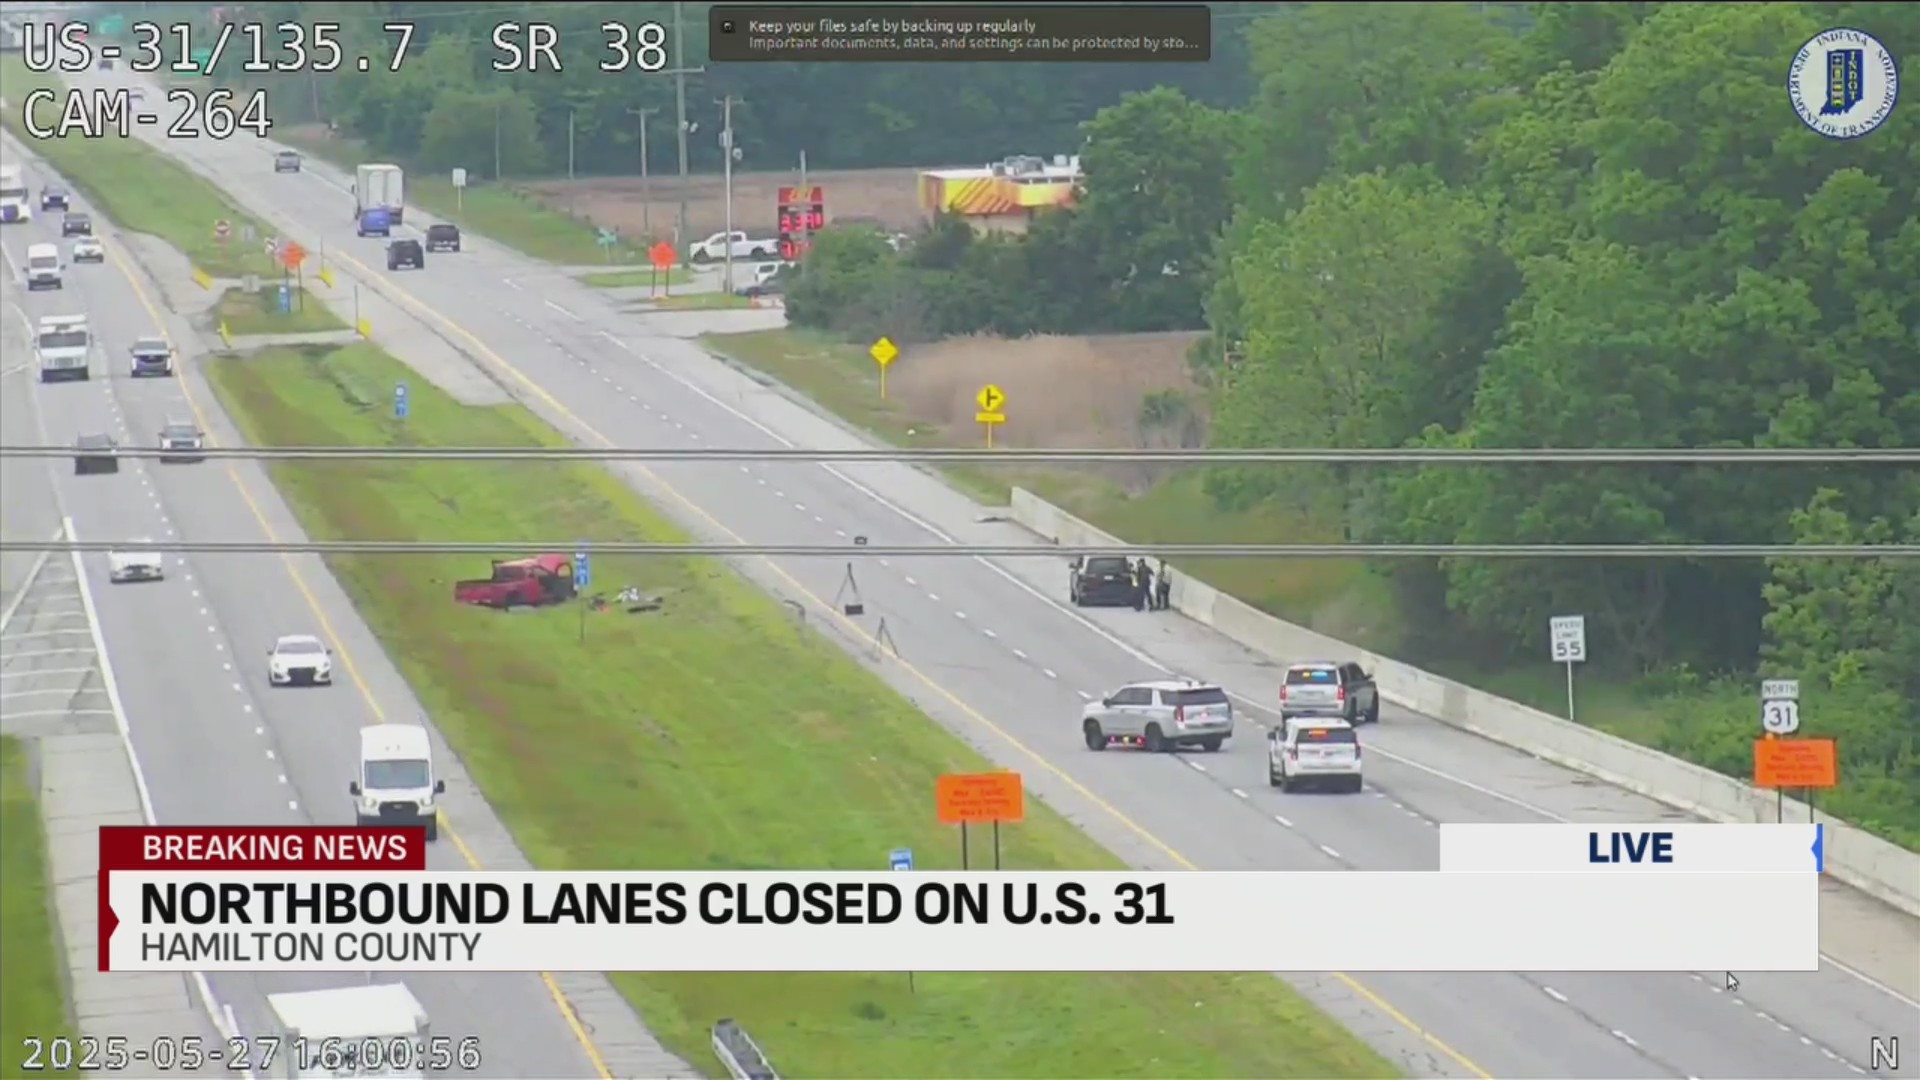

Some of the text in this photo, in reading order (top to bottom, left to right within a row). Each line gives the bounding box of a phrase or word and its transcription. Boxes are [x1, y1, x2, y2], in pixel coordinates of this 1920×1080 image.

[1556, 641, 1582, 657] 55
[1764, 684, 1797, 695] NORTH
[1769, 706, 1792, 727] 31
